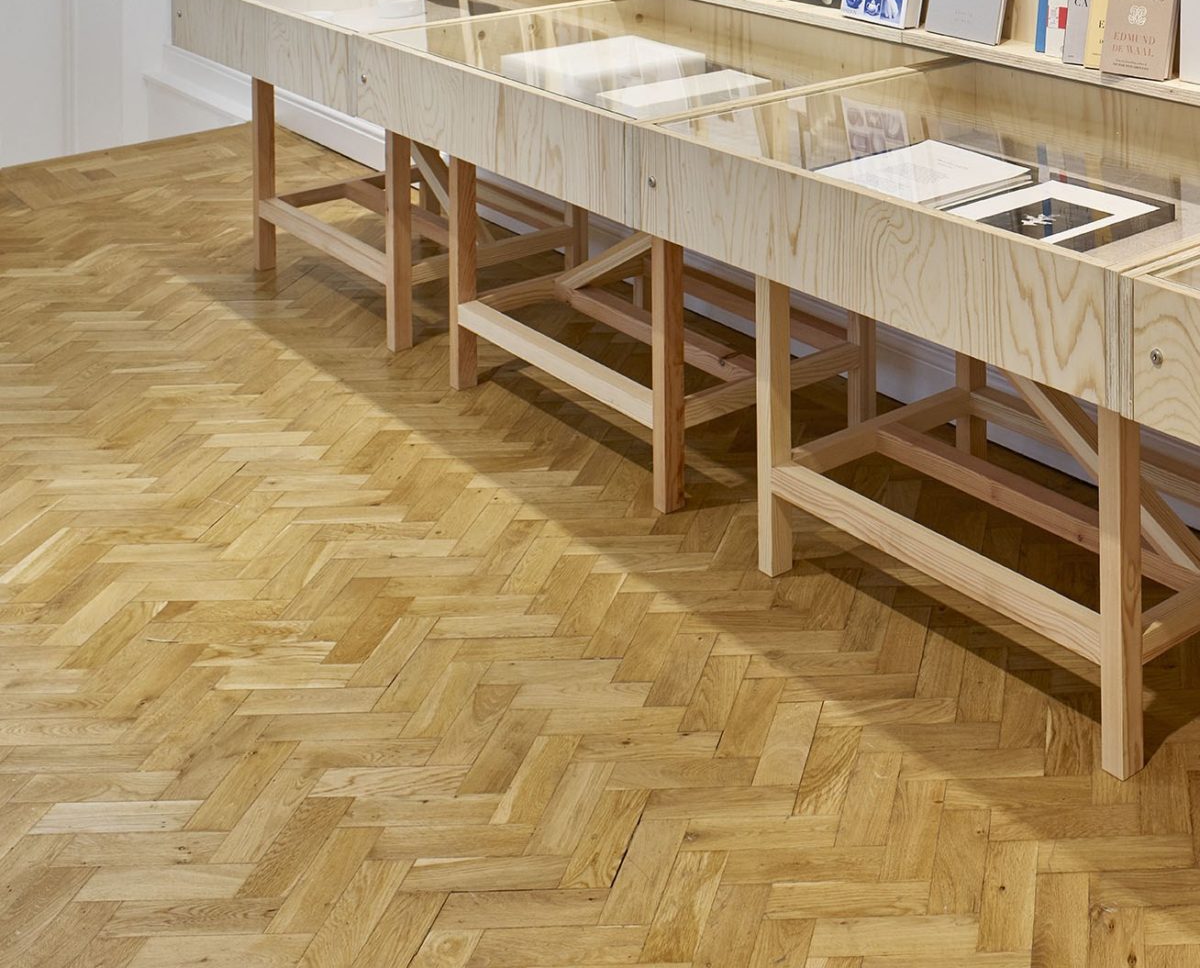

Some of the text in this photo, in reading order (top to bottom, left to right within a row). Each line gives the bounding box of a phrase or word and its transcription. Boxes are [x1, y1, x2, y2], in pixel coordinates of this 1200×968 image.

[1113, 31, 1156, 45] EDMUND
[1112, 43, 1154, 57] DE WAAL
